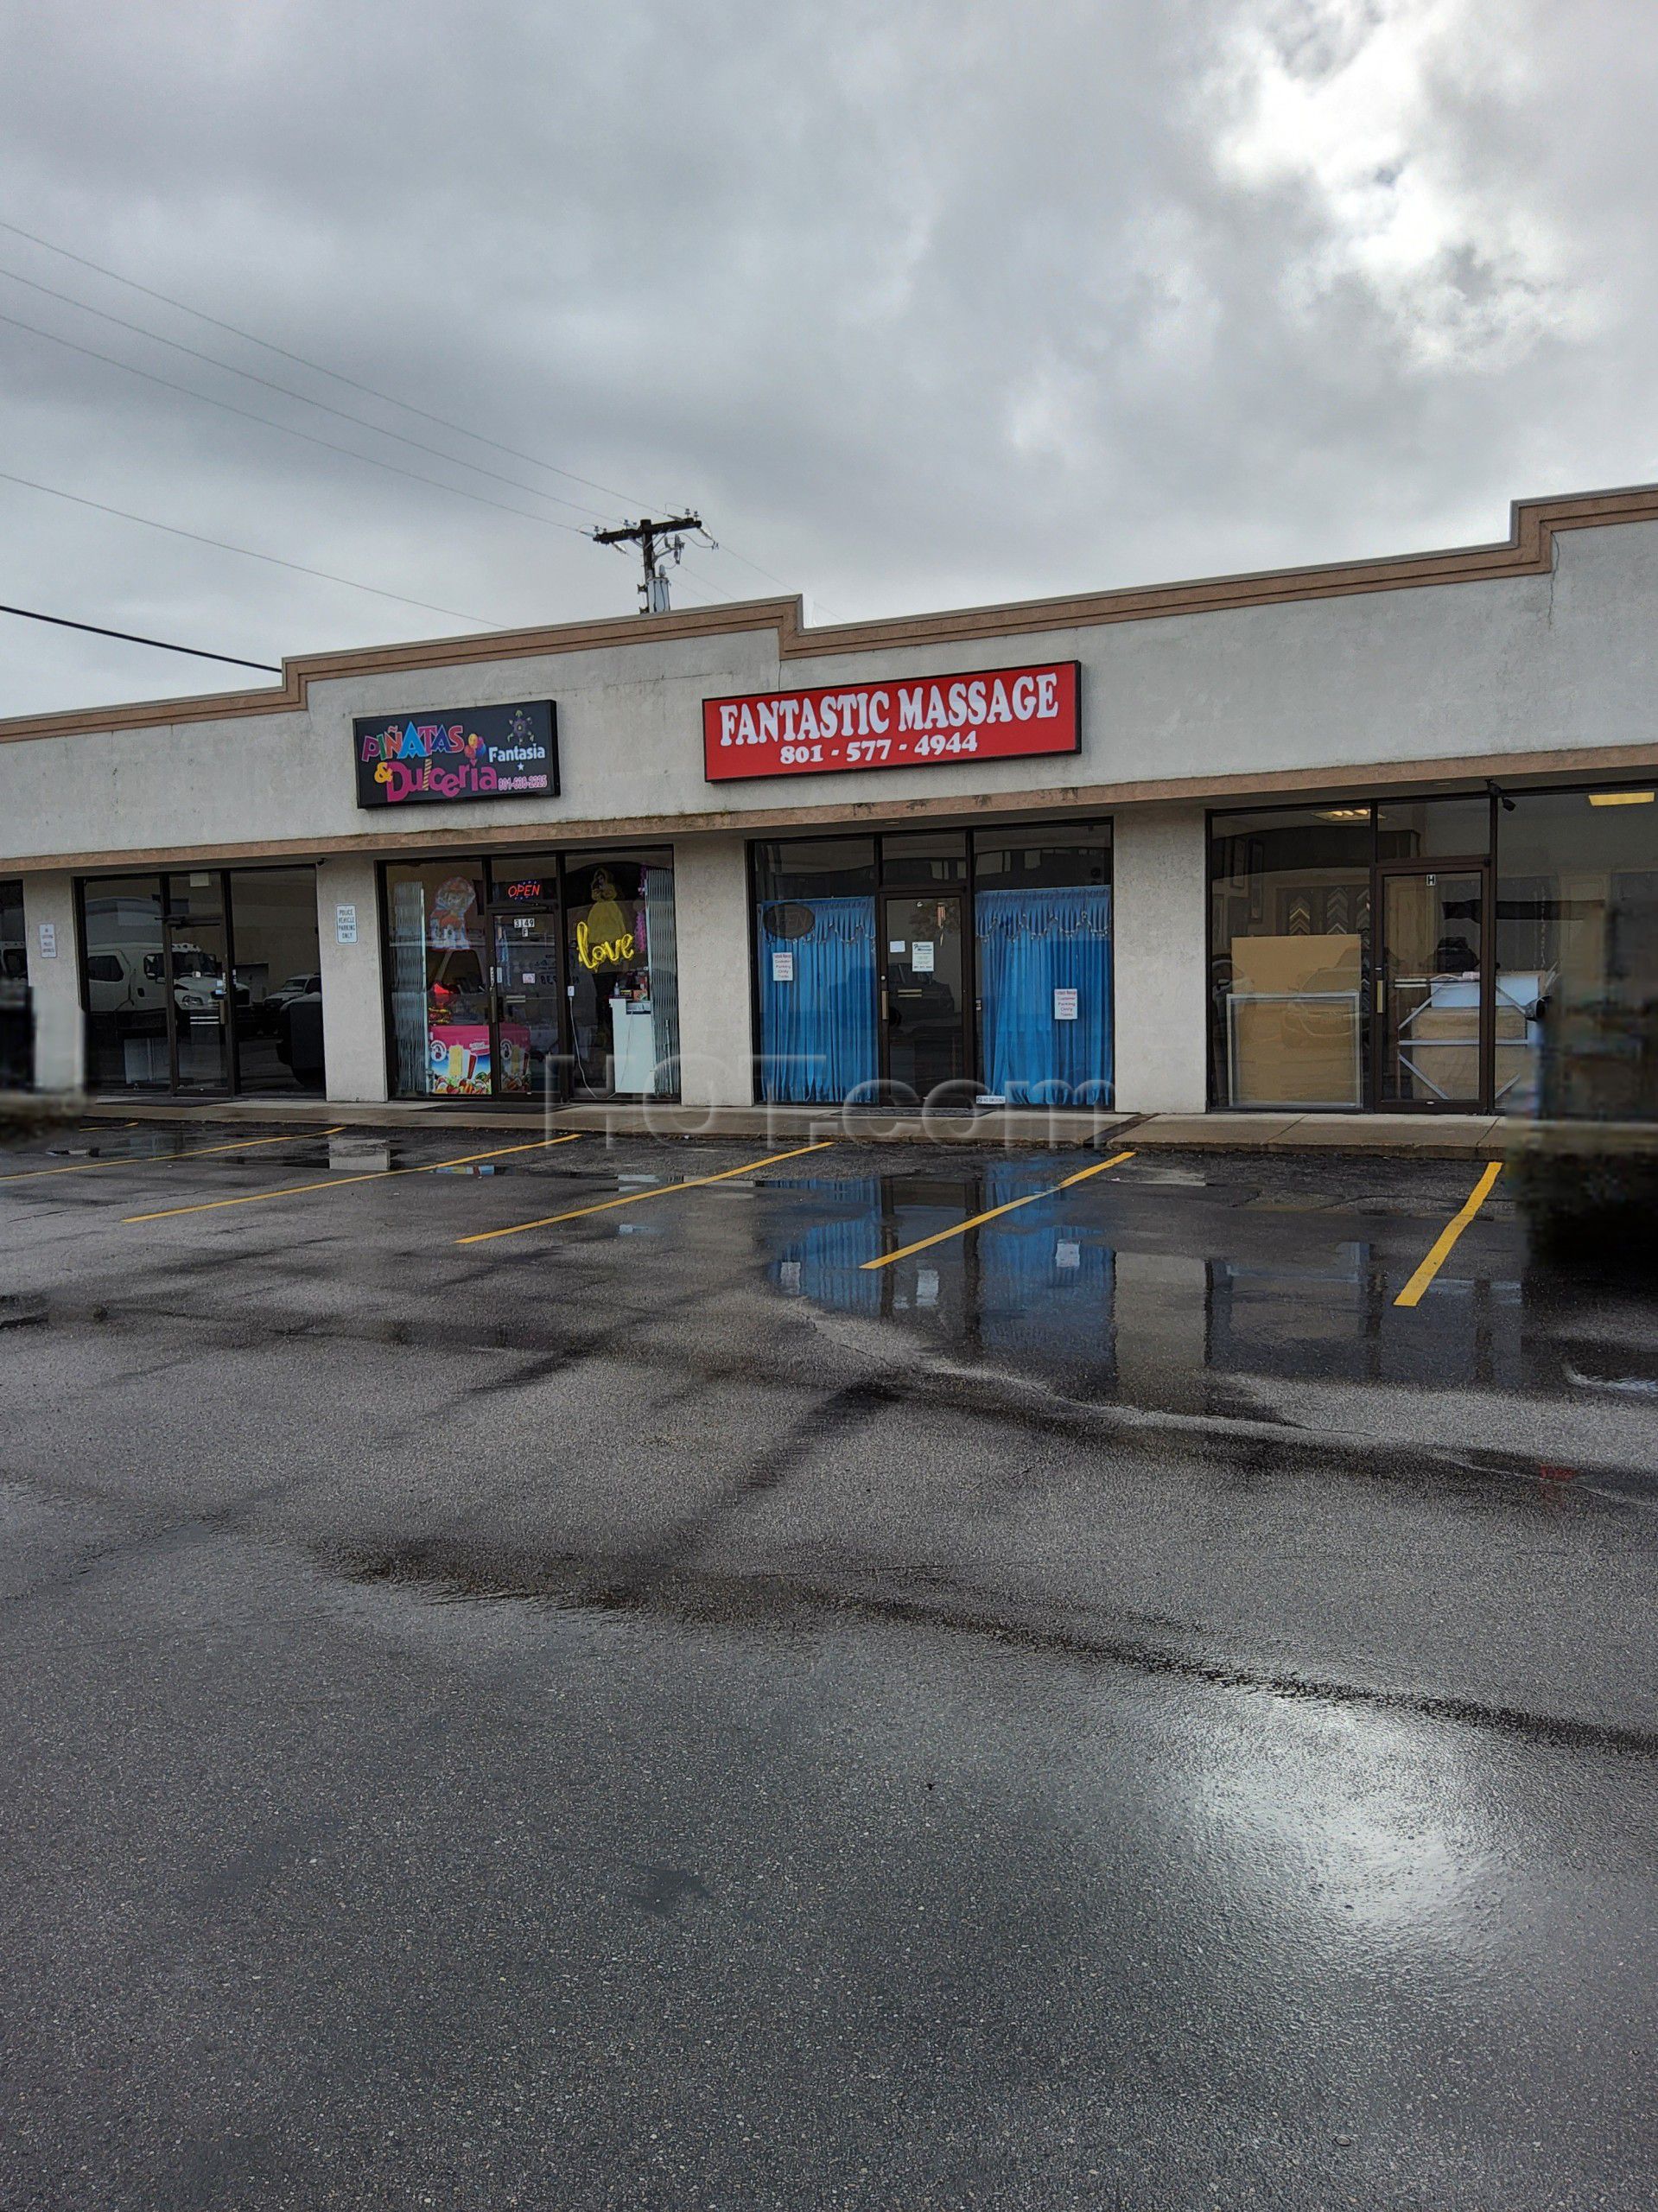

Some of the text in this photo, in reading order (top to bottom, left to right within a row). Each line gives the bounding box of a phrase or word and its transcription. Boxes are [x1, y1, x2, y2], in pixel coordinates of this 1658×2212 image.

[719, 672, 1059, 747] FANTASTIC MASSAGE
[361, 721, 465, 762] PIÑATAS
[489, 743, 546, 763] Fantasia
[779, 744, 823, 765] 801
[846, 738, 892, 762] 577
[914, 730, 977, 755] 4944
[374, 761, 394, 784] &
[508, 884, 540, 898] OPEN
[1427, 875, 1434, 886] H
[515, 919, 534, 928] 3149
[577, 921, 634, 969] love
